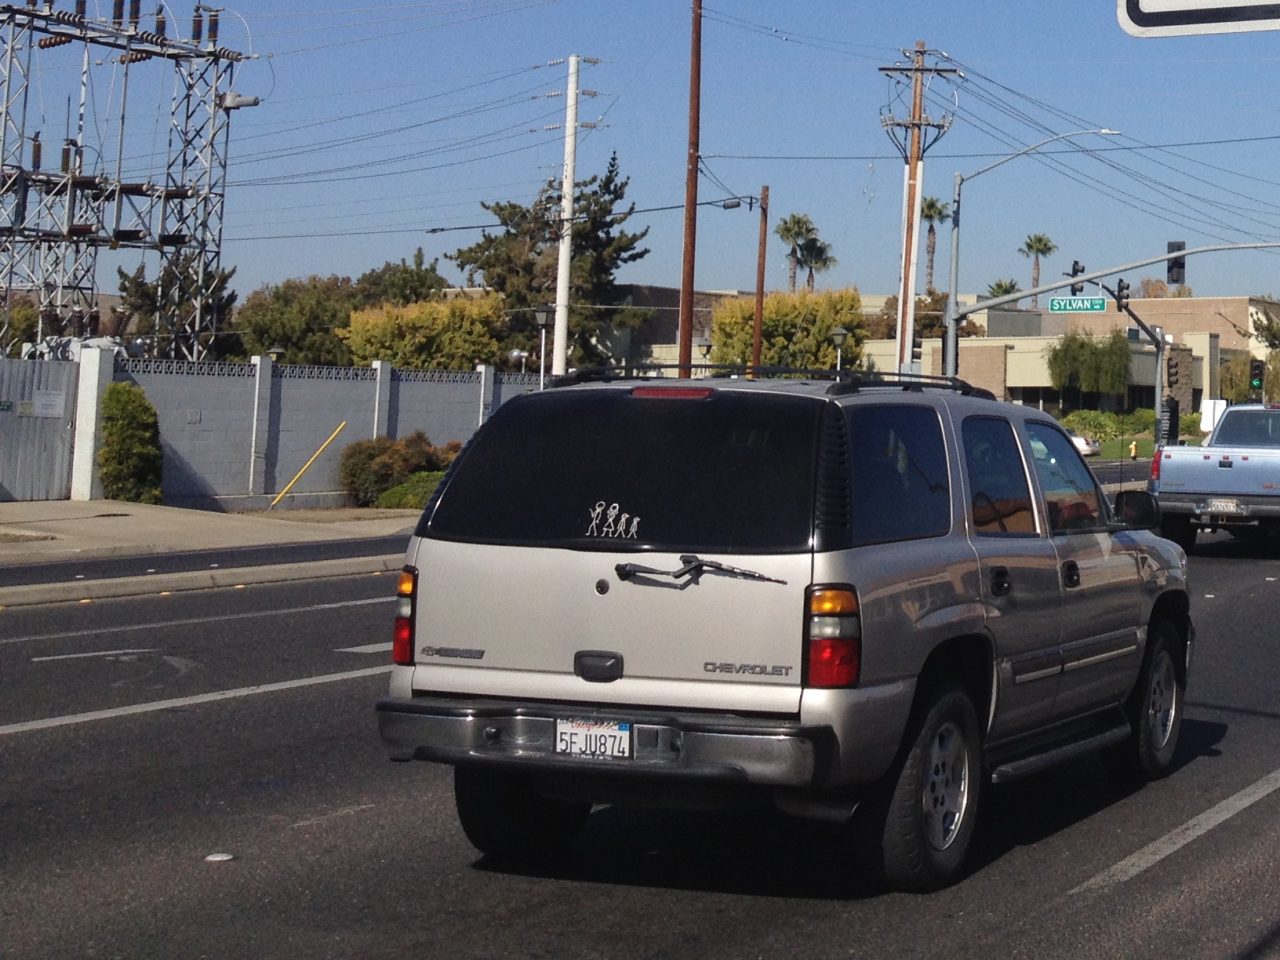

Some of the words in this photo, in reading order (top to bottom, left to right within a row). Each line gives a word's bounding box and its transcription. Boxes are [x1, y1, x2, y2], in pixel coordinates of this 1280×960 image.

[1052, 299, 1091, 310] SYLVAN
[703, 662, 793, 676] CHEVROLET
[560, 732, 626, 756] 5FJU874
